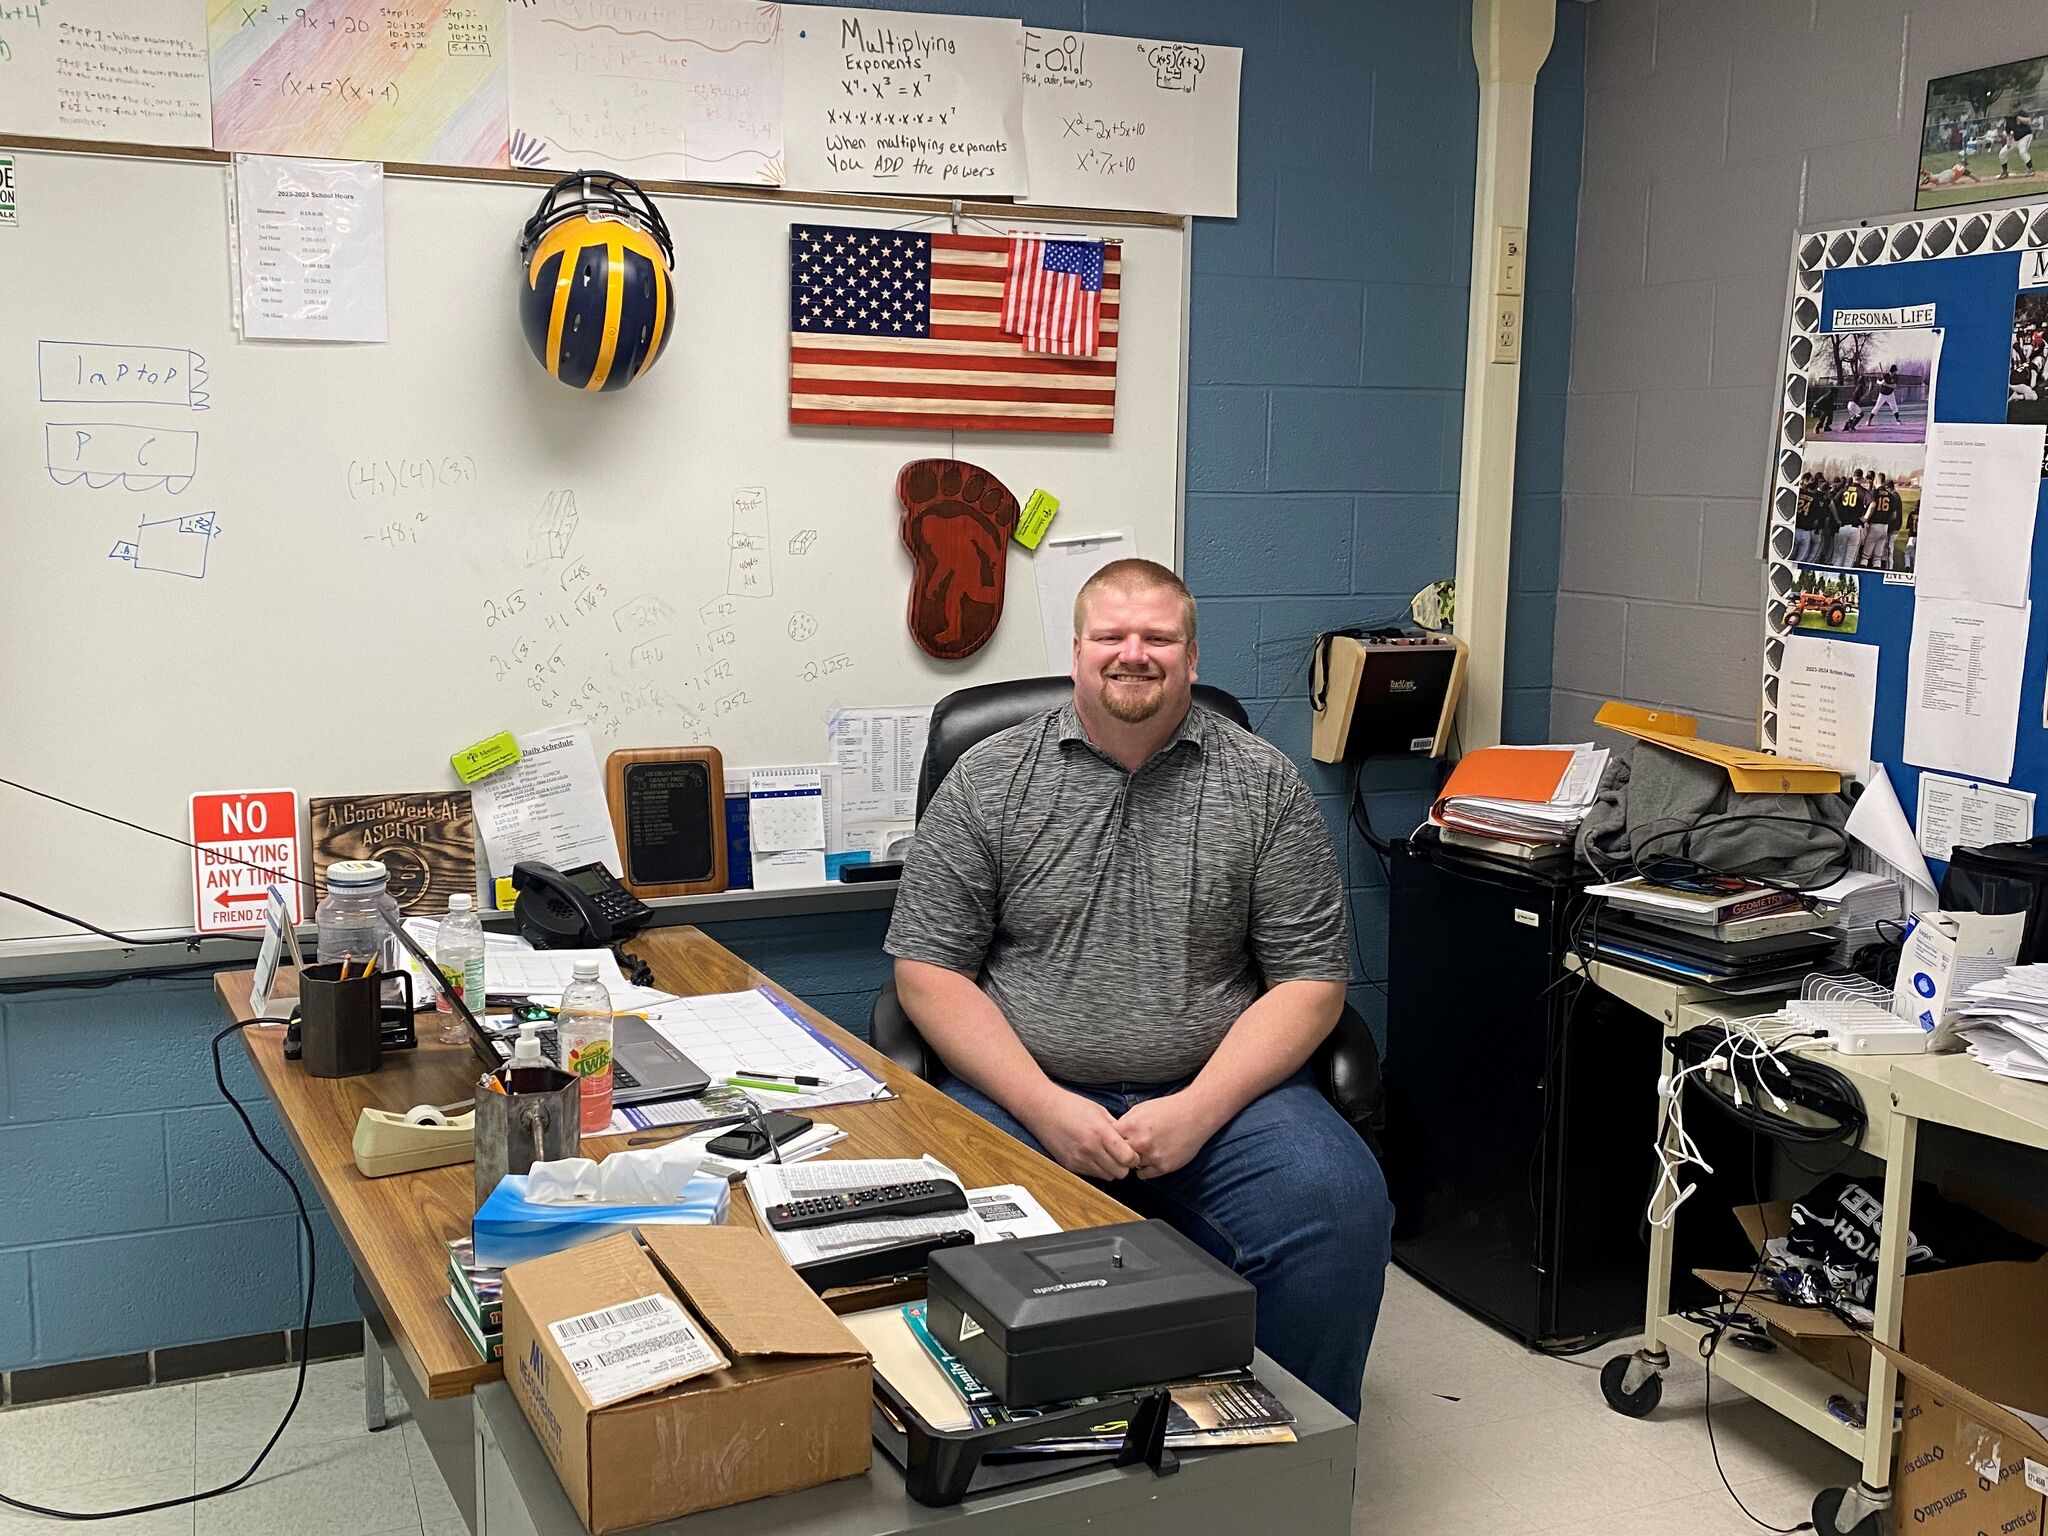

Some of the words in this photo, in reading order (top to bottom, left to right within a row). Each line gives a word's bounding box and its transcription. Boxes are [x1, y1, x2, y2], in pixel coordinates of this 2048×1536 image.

[380, 8, 402, 19] Step
[841, 18, 956, 58] Multiplying
[845, 54, 921, 74] Exponents
[826, 134, 866, 151] When
[877, 134, 944, 155] multiplying
[950, 139, 1007, 156] exponents
[827, 154, 864, 173] You
[874, 154, 904, 172] ADD
[913, 157, 934, 175] the
[943, 165, 995, 180] powers
[1834, 309, 1897, 326] PERSONAL
[1900, 307, 1933, 324] LIFE
[1842, 491, 1857, 507] 30
[522, 745, 542, 757] Daily
[541, 739, 574, 752] Schedule
[222, 801, 267, 834] NO
[327, 804, 338, 828] A
[344, 802, 386, 825] Good
[389, 799, 436, 820] Week
[440, 799, 459, 821] At
[362, 822, 427, 848] ASCENT
[204, 844, 288, 866] BULLYING
[207, 869, 242, 888] ANY
[247, 866, 288, 886] TIME
[1732, 893, 1783, 915] GEOMETRY
[213, 910, 252, 923] FRIEND
[256, 909, 267, 920] ZO
[1943, 1488, 1968, 1508] sam's
[2001, 1514, 2023, 1534] sam's
